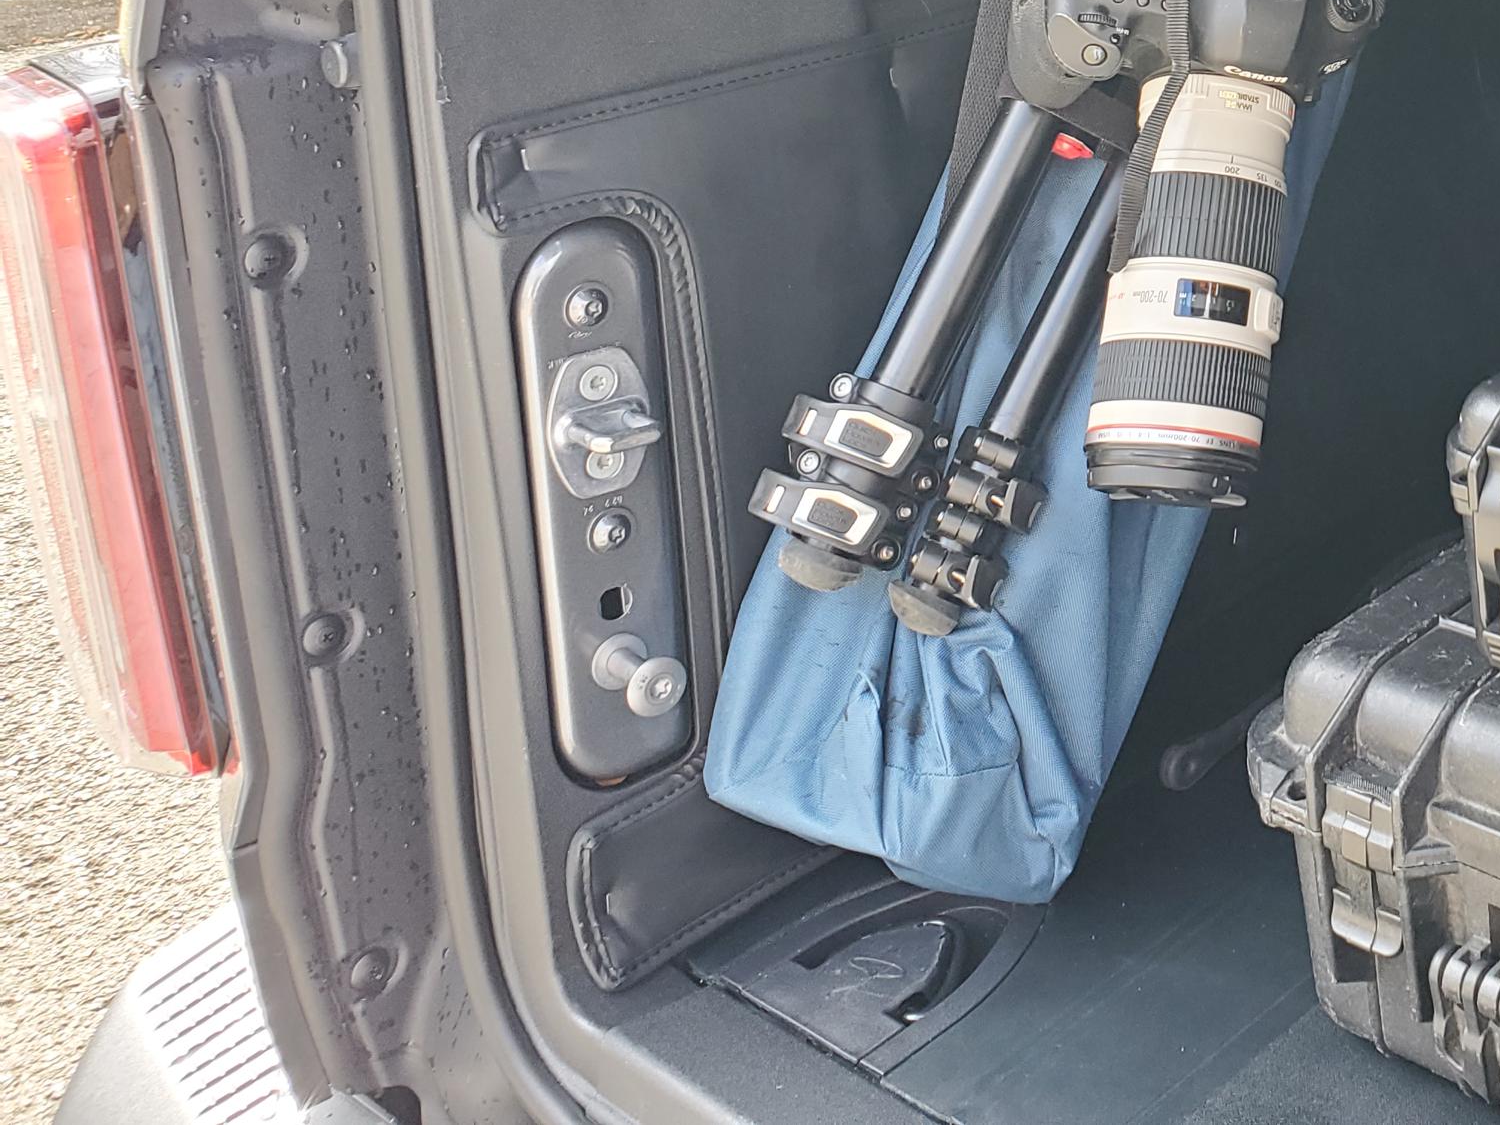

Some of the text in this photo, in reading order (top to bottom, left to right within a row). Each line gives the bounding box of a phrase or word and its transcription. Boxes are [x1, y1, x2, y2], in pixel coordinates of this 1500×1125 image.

[1223, 65, 1289, 84] Canon
[1224, 166, 1240, 175] 200
[1256, 172, 1268, 182] 135
